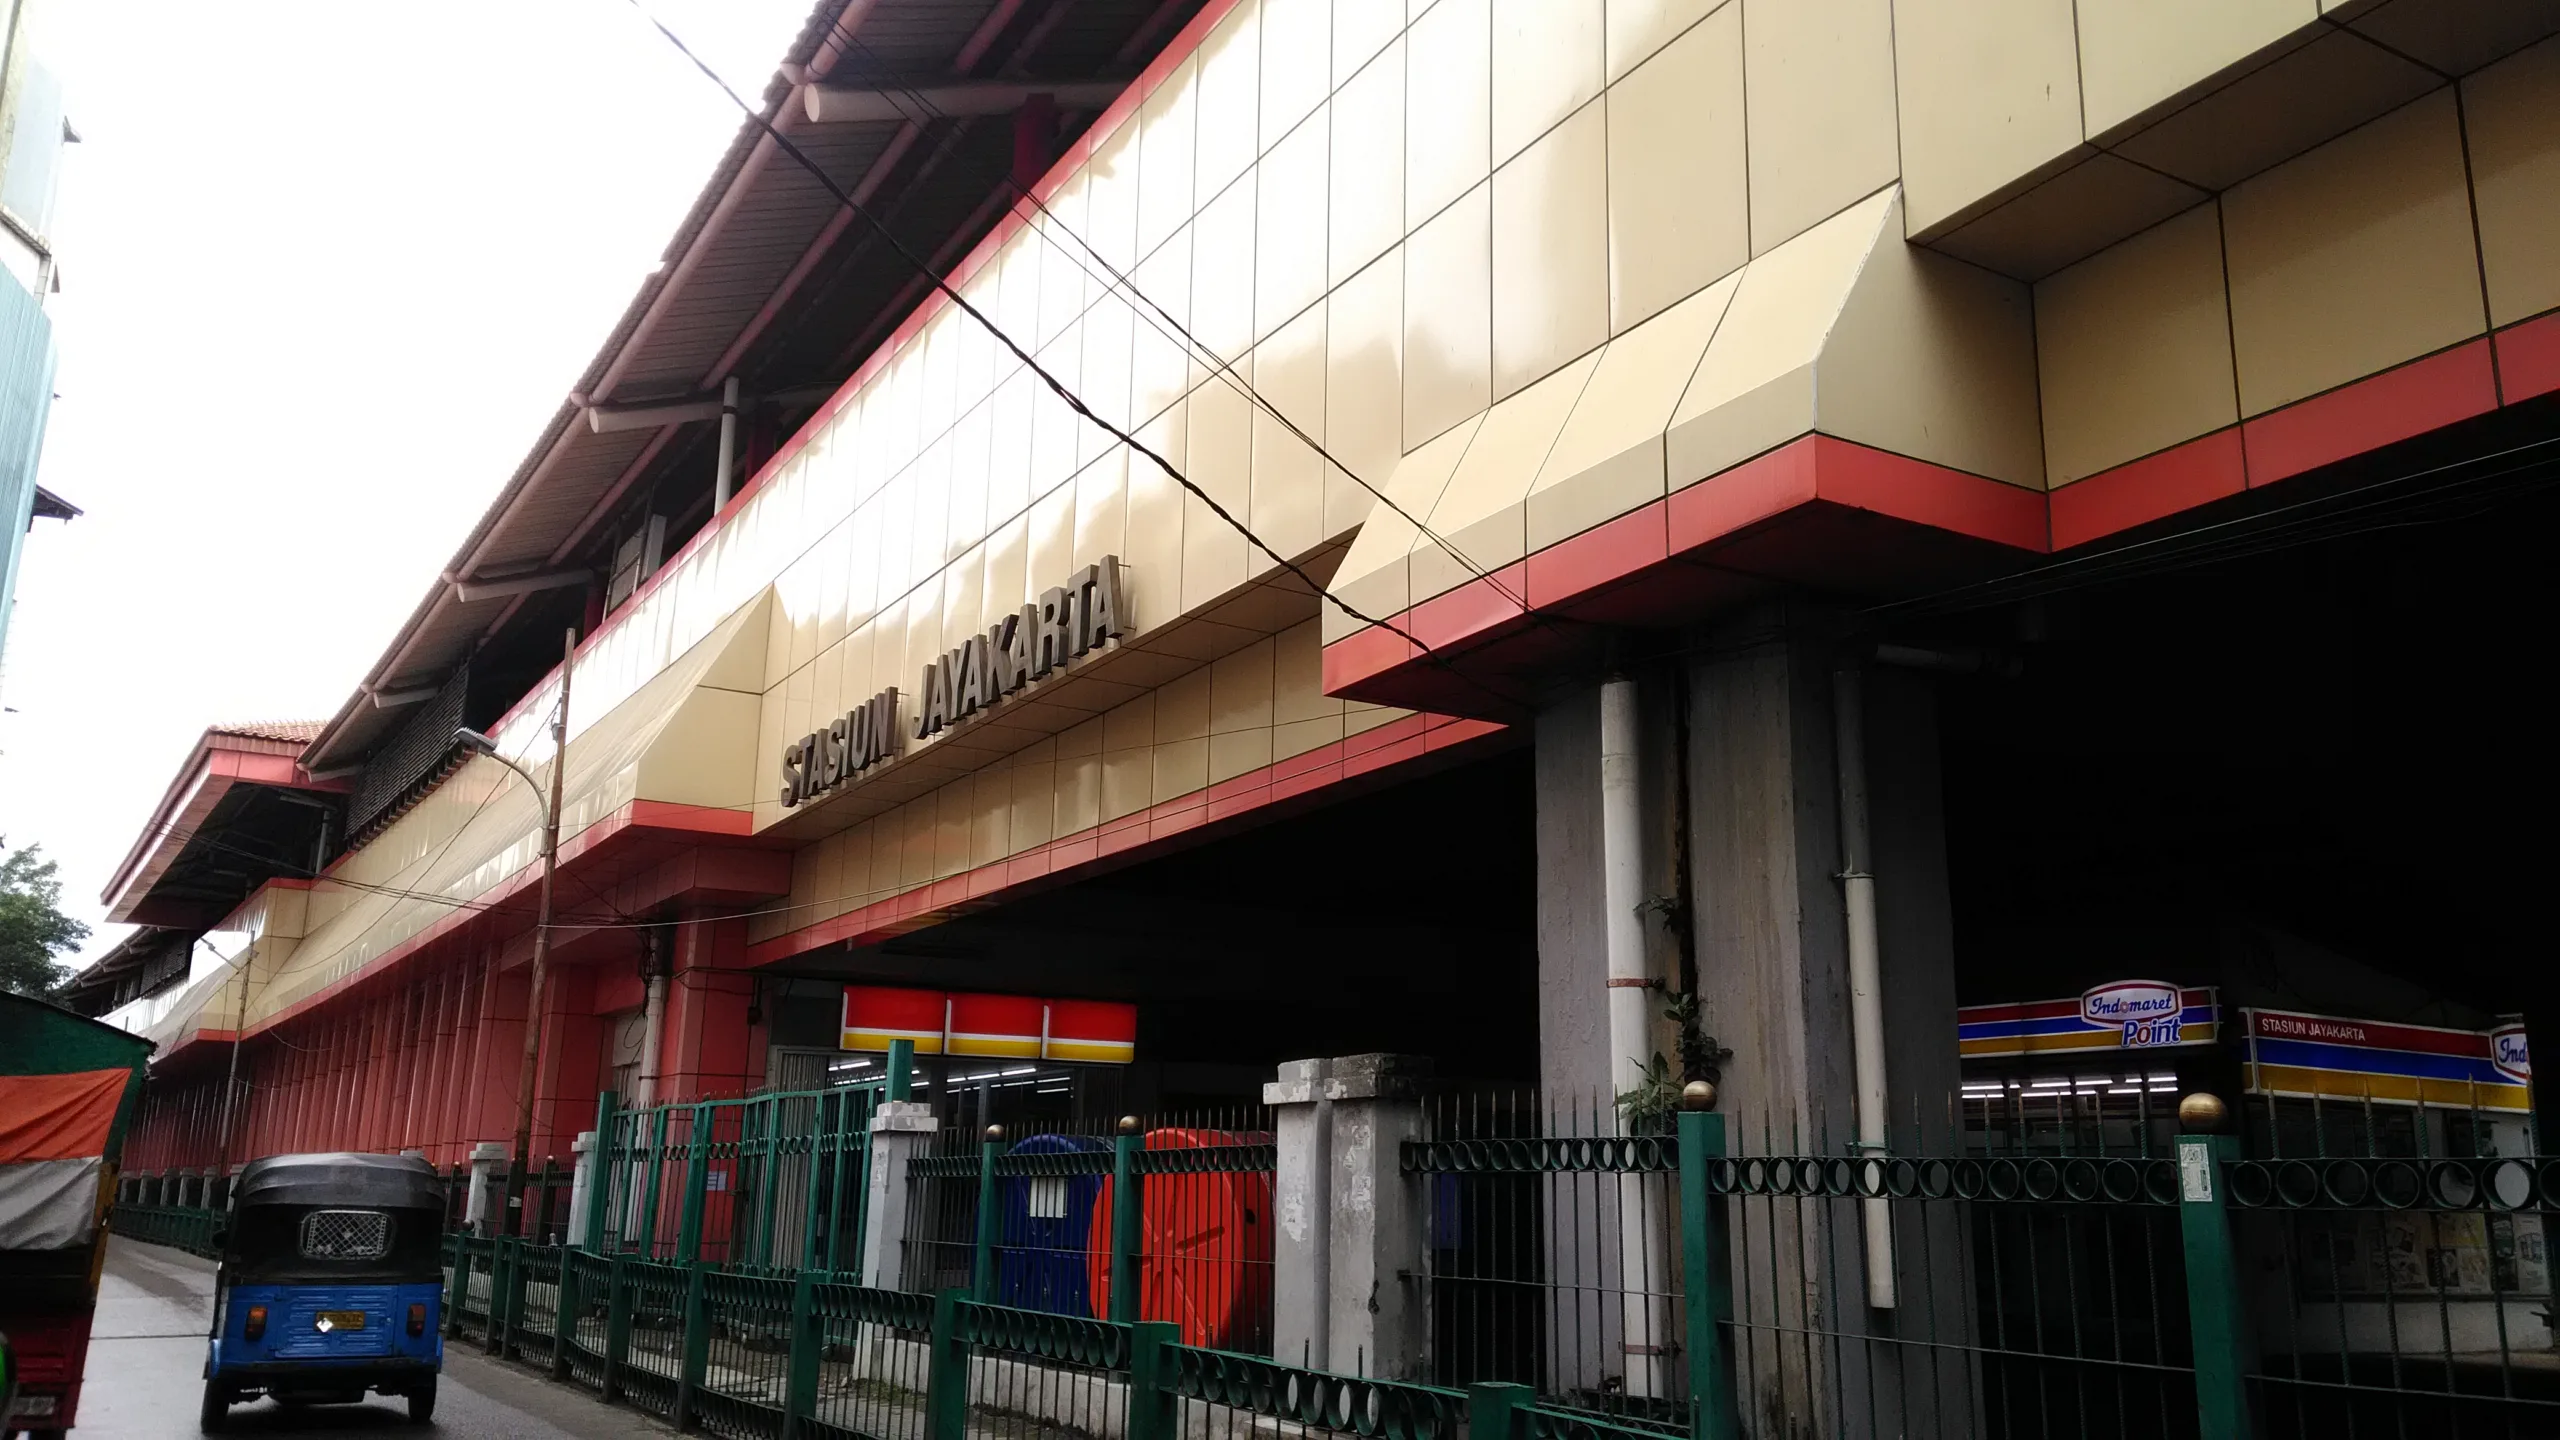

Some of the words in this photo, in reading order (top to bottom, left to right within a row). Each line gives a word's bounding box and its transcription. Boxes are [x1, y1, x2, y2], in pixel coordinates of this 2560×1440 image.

[781, 686, 898, 807] STASIUN
[911, 554, 1124, 739] JAYAKARTA
[2089, 993, 2172, 1015] Indomaret
[2121, 1017, 2182, 1046] Point
[2262, 1018, 2306, 1034] STASIUN
[2308, 1022, 2366, 1041] JAYAKARTA
